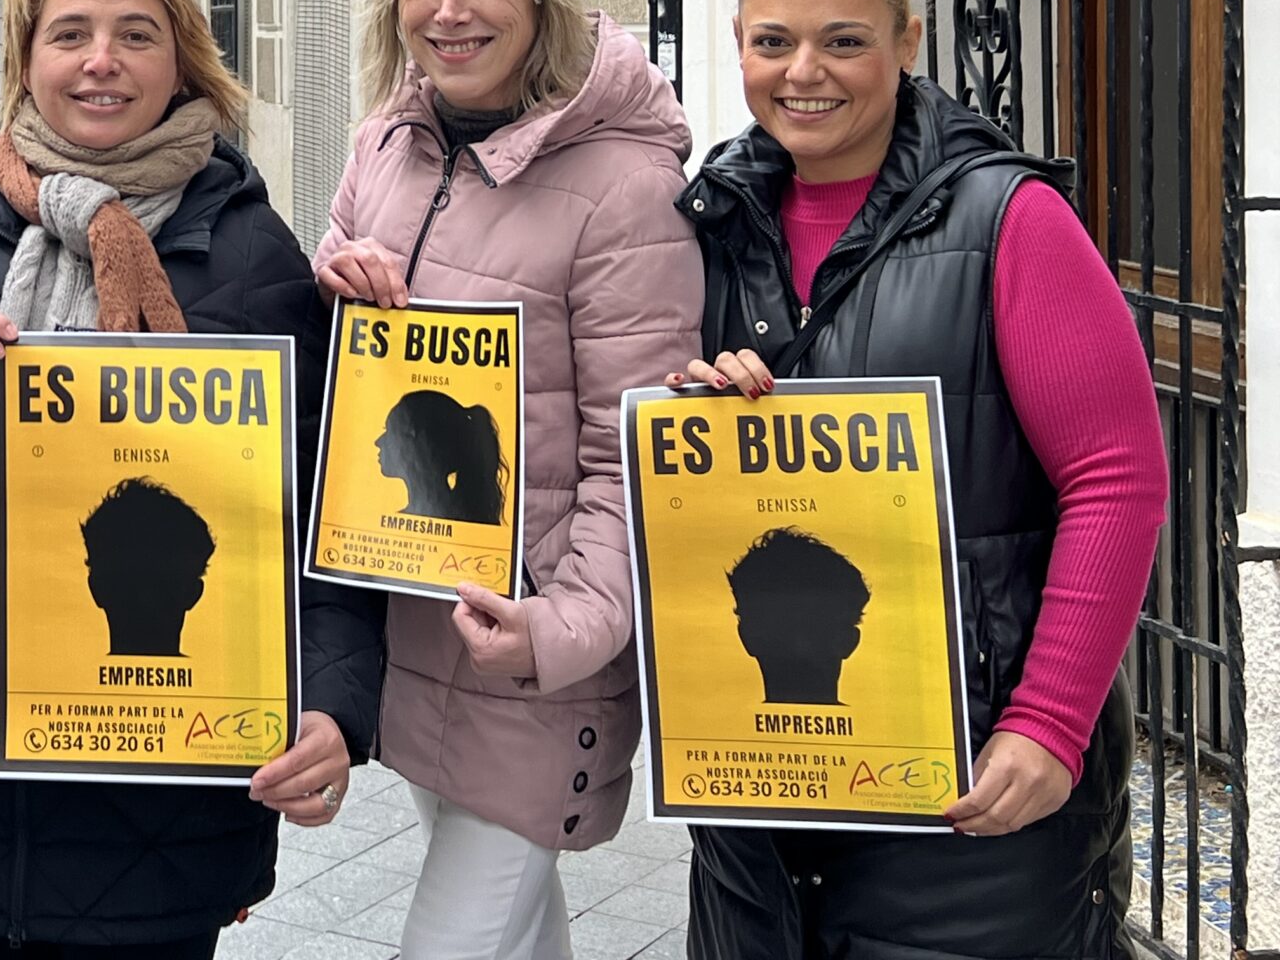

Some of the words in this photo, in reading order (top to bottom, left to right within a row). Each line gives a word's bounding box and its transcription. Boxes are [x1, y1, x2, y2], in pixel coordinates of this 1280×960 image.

[349, 317, 390, 359] ES
[404, 323, 510, 368] BUSCA
[411, 373, 450, 386] BENISSA
[18, 364, 75, 423] ES
[100, 365, 268, 426] BUSCA
[650, 416, 713, 475] ES
[736, 412, 919, 474] BUSCA
[113, 448, 170, 463] BENISSA
[757, 498, 818, 513] BENISSA
[380, 515, 453, 537] EMPRESÀRIA
[342, 554, 365, 567] 634
[369, 557, 385, 569] 30
[388, 560, 403, 572] 20
[406, 563, 422, 575] 61
[439, 553, 508, 585] ACEB
[99, 666, 193, 688] EMPRESARI
[31, 704, 51, 716] PER
[56, 704, 63, 716] A
[68, 705, 114, 717] FORMAR
[120, 706, 147, 718] PART
[153, 707, 166, 718] DE
[171, 707, 184, 719] LA
[48, 721, 92, 733] NOSTRA
[97, 720, 166, 735] ASSOCIACIÓ
[185, 708, 282, 754] ACEB
[755, 713, 853, 736] EMPRESARI
[50, 735, 84, 751] 634
[89, 735, 111, 752] 30
[116, 736, 138, 752] 20
[143, 737, 164, 753] 61
[686, 750, 709, 761] PER
[713, 750, 720, 762] A
[725, 751, 774, 764] FORMAR
[778, 753, 808, 765] PART
[814, 755, 827, 766] DE
[832, 755, 846, 767] LA
[706, 766, 753, 780] NOSTRA
[757, 767, 828, 782] ASSOCIACIÓ
[849, 757, 951, 802] ACEB
[709, 780, 744, 797] 634
[749, 781, 772, 797] 30
[778, 782, 801, 798] 20
[806, 782, 828, 799] 61
